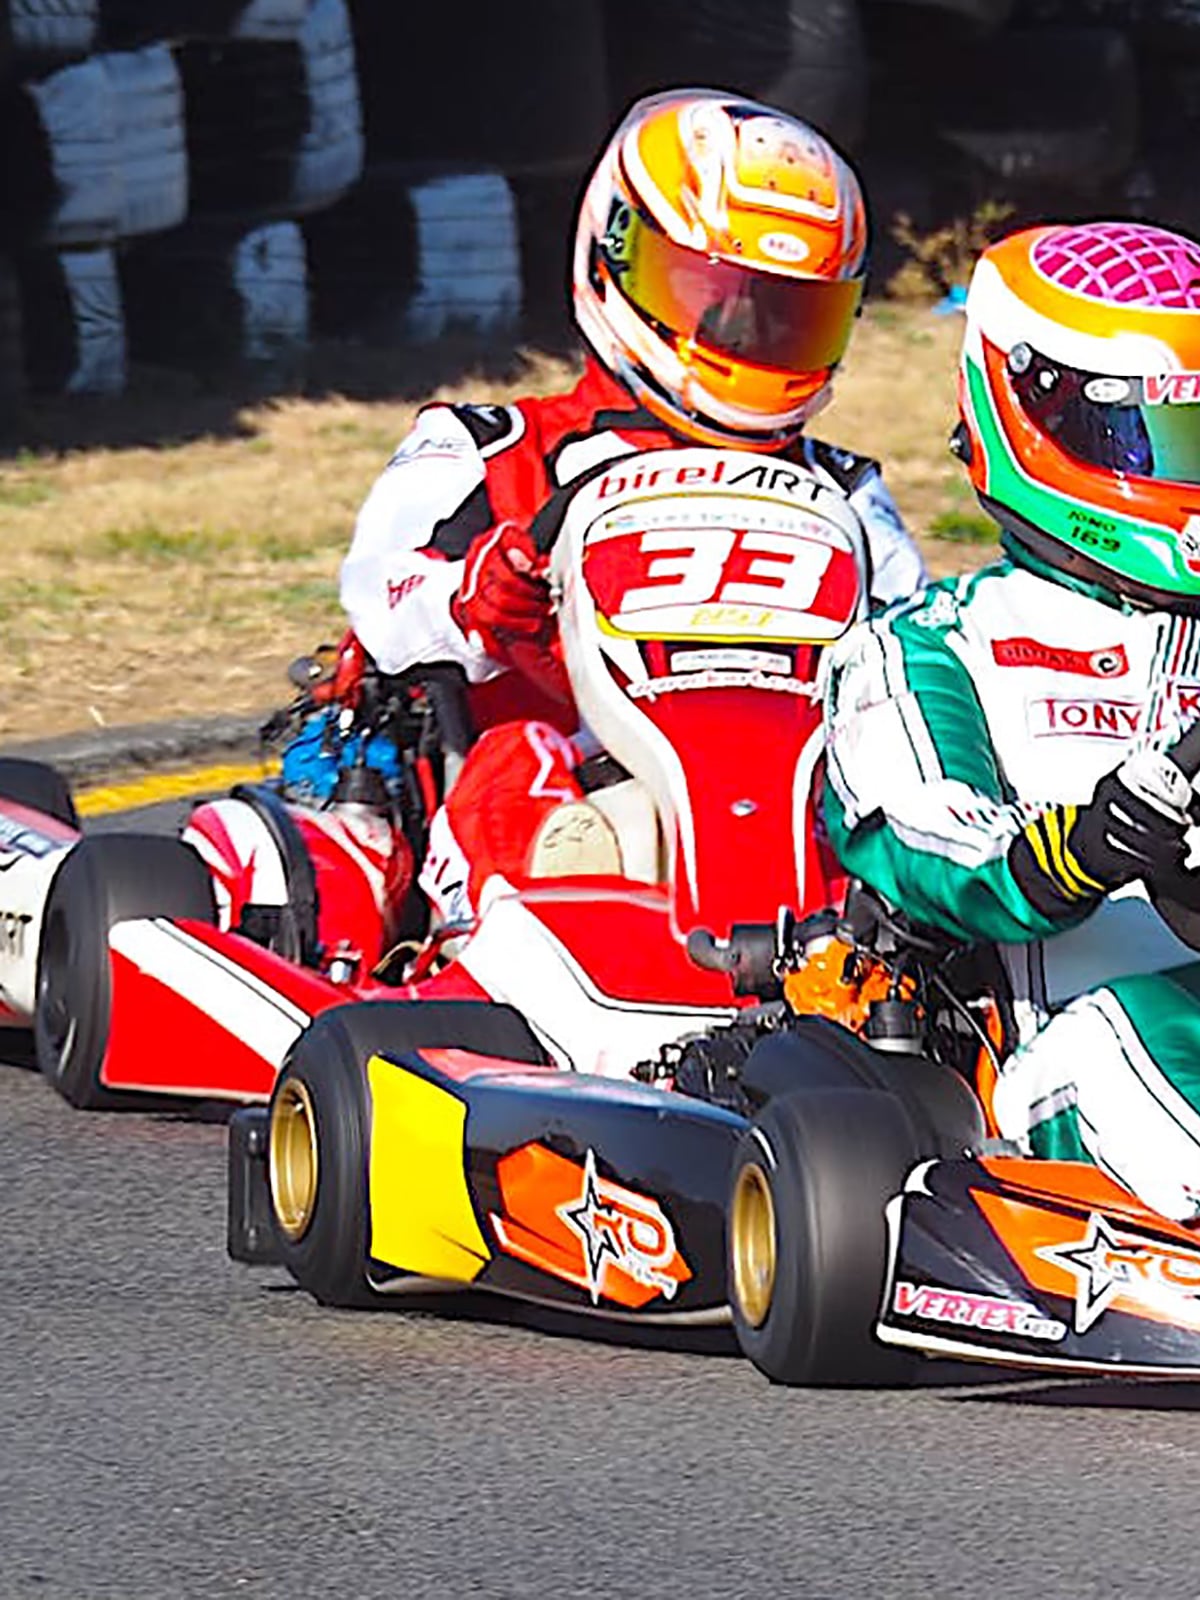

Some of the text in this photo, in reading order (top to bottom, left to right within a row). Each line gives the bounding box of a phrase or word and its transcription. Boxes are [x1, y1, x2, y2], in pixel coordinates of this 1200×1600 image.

[1071, 525, 1121, 552] 169
[619, 528, 834, 614] 33
[1045, 699, 1142, 733] TONY
[897, 1285, 1026, 1332] VERTEX
